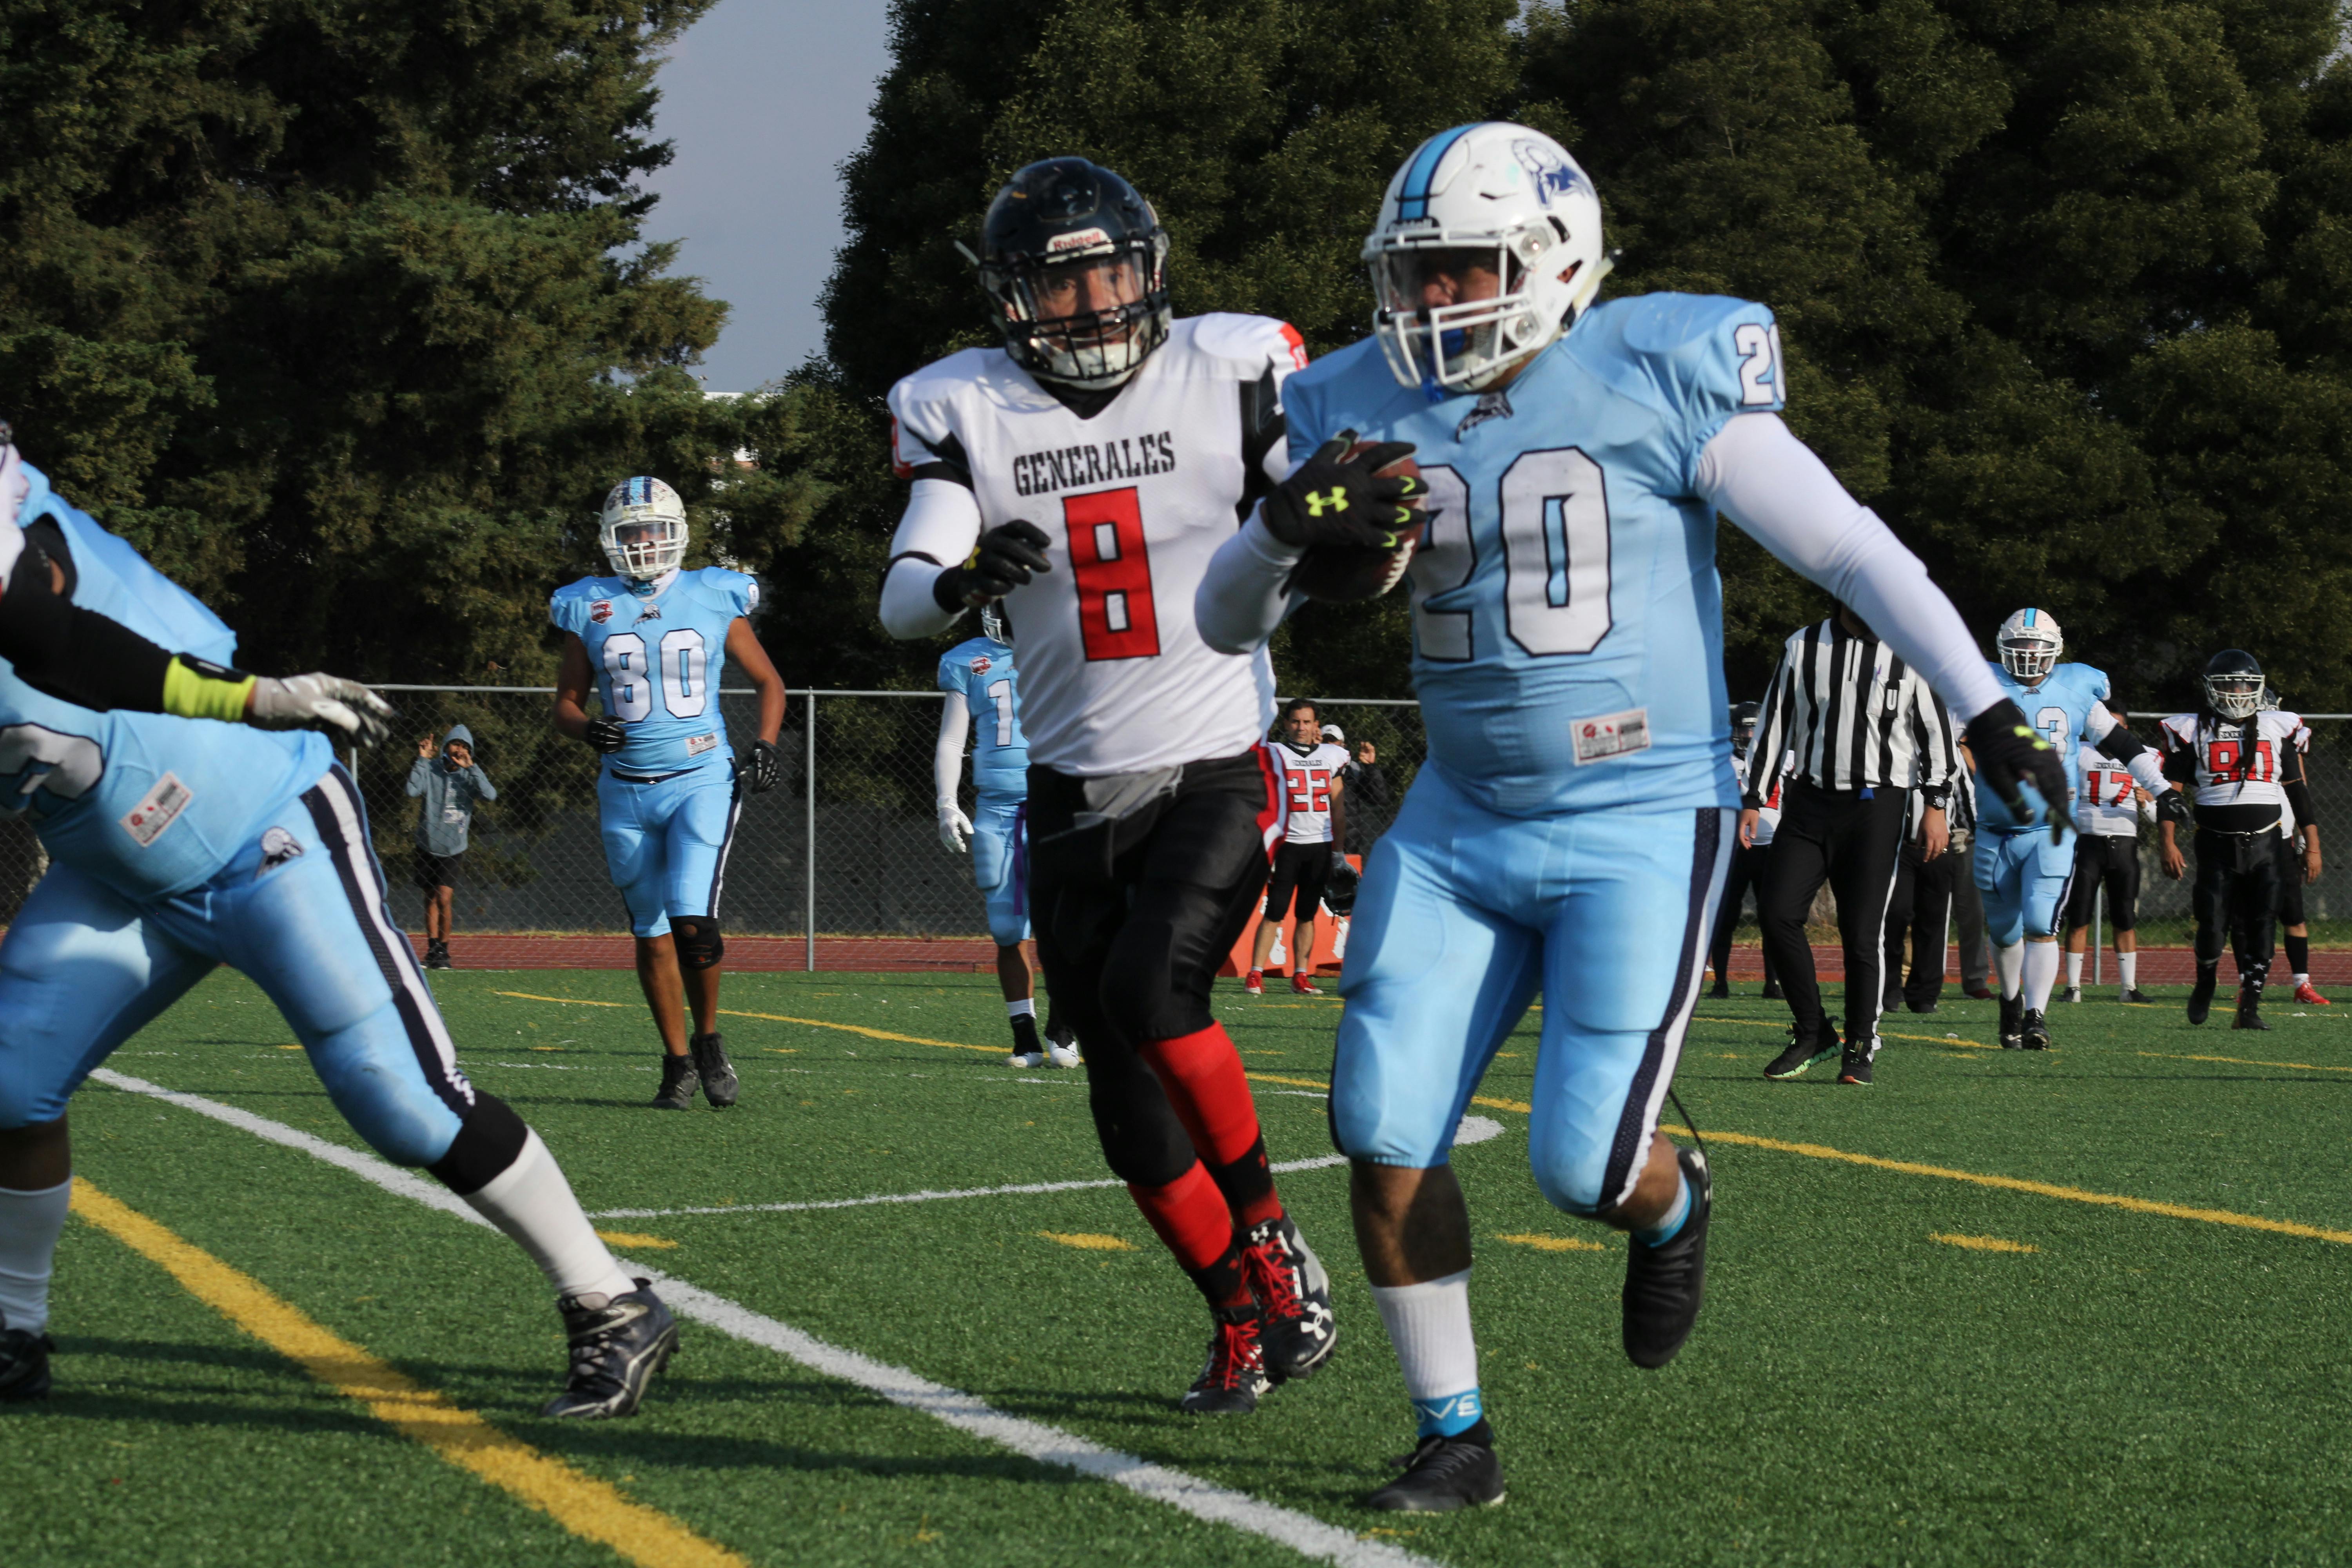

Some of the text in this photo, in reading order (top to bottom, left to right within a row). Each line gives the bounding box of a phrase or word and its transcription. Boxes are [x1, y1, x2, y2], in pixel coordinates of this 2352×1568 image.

[1013, 430, 1176, 497] GENERALES
[1061, 486, 1160, 662] 8
[603, 628, 707, 723] 80
[1886, 688, 1898, 711] U
[988, 678, 1029, 746] 1
[2016, 705, 2070, 764] 3
[1287, 769, 1330, 813] 22
[2087, 771, 2133, 808] 17
[2208, 739, 2273, 786] 90
